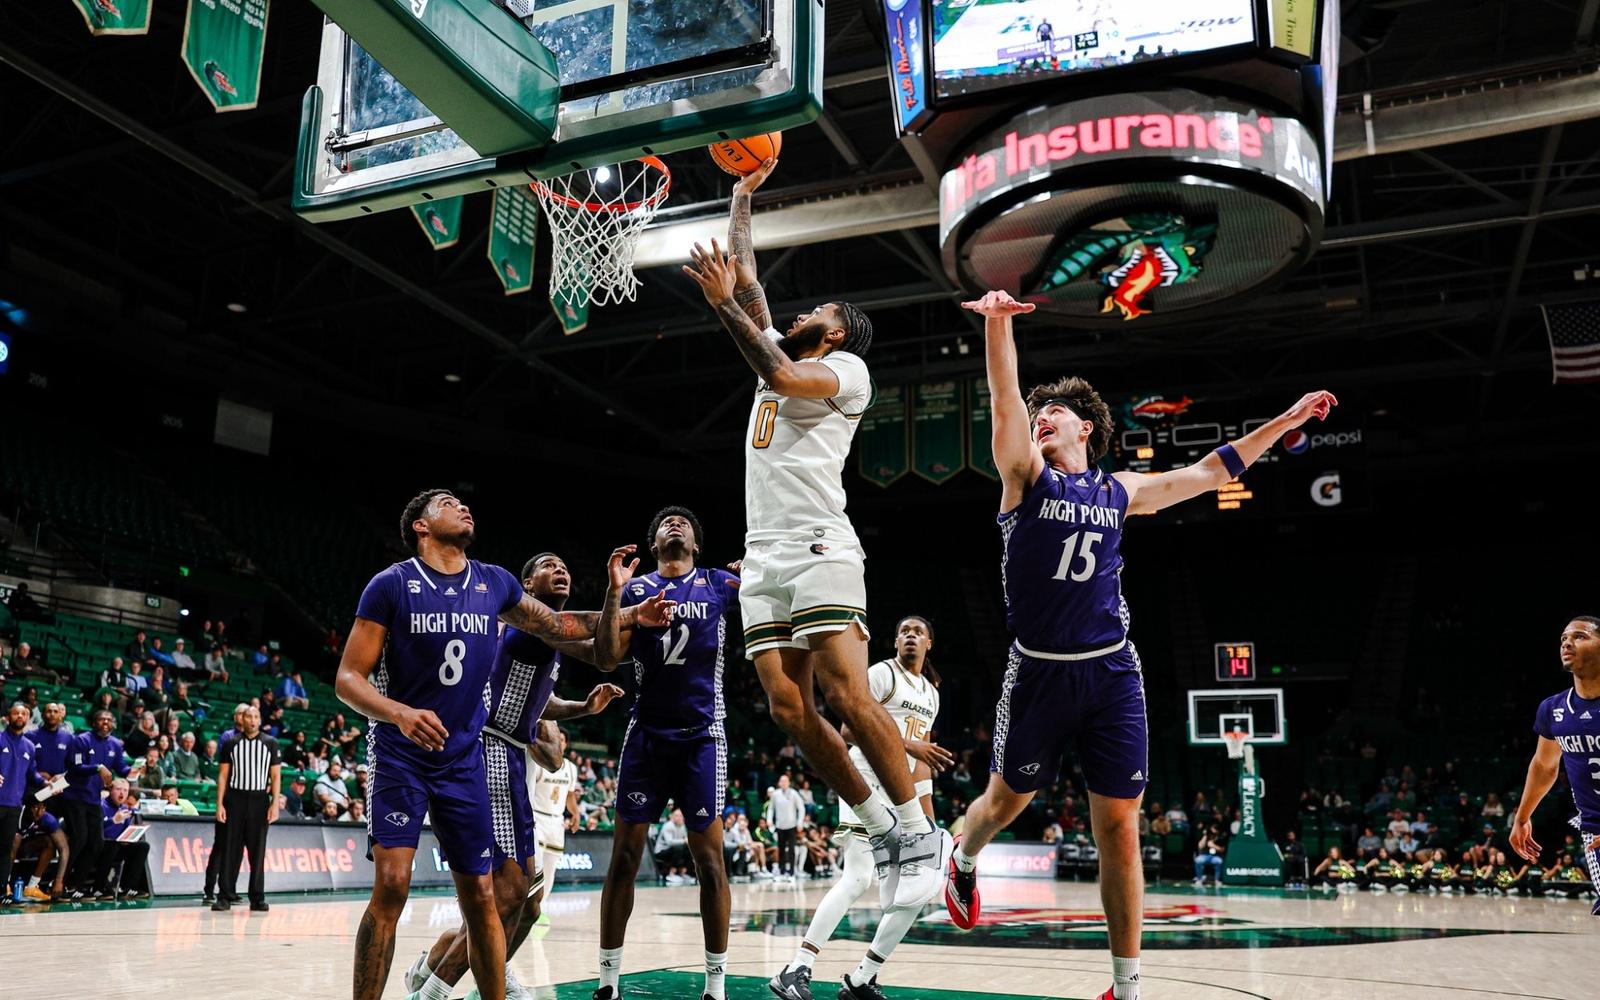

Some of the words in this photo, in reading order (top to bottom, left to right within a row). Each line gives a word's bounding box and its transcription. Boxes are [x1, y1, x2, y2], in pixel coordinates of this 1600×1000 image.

[1005, 112, 1263, 178] Insurance
[752, 399, 779, 449] 0
[1310, 429, 1363, 450] pepsi
[1038, 498, 1079, 524] HIGH
[1080, 504, 1120, 530] POINT
[1052, 531, 1104, 583] 15
[410, 612, 447, 634] HIGH
[451, 612, 490, 636] POINT
[438, 638, 467, 686] 8
[660, 623, 691, 666] 12
[1230, 658, 1249, 676] 14
[901, 700, 934, 719] BLAZERS
[162, 837, 214, 874] Alf
